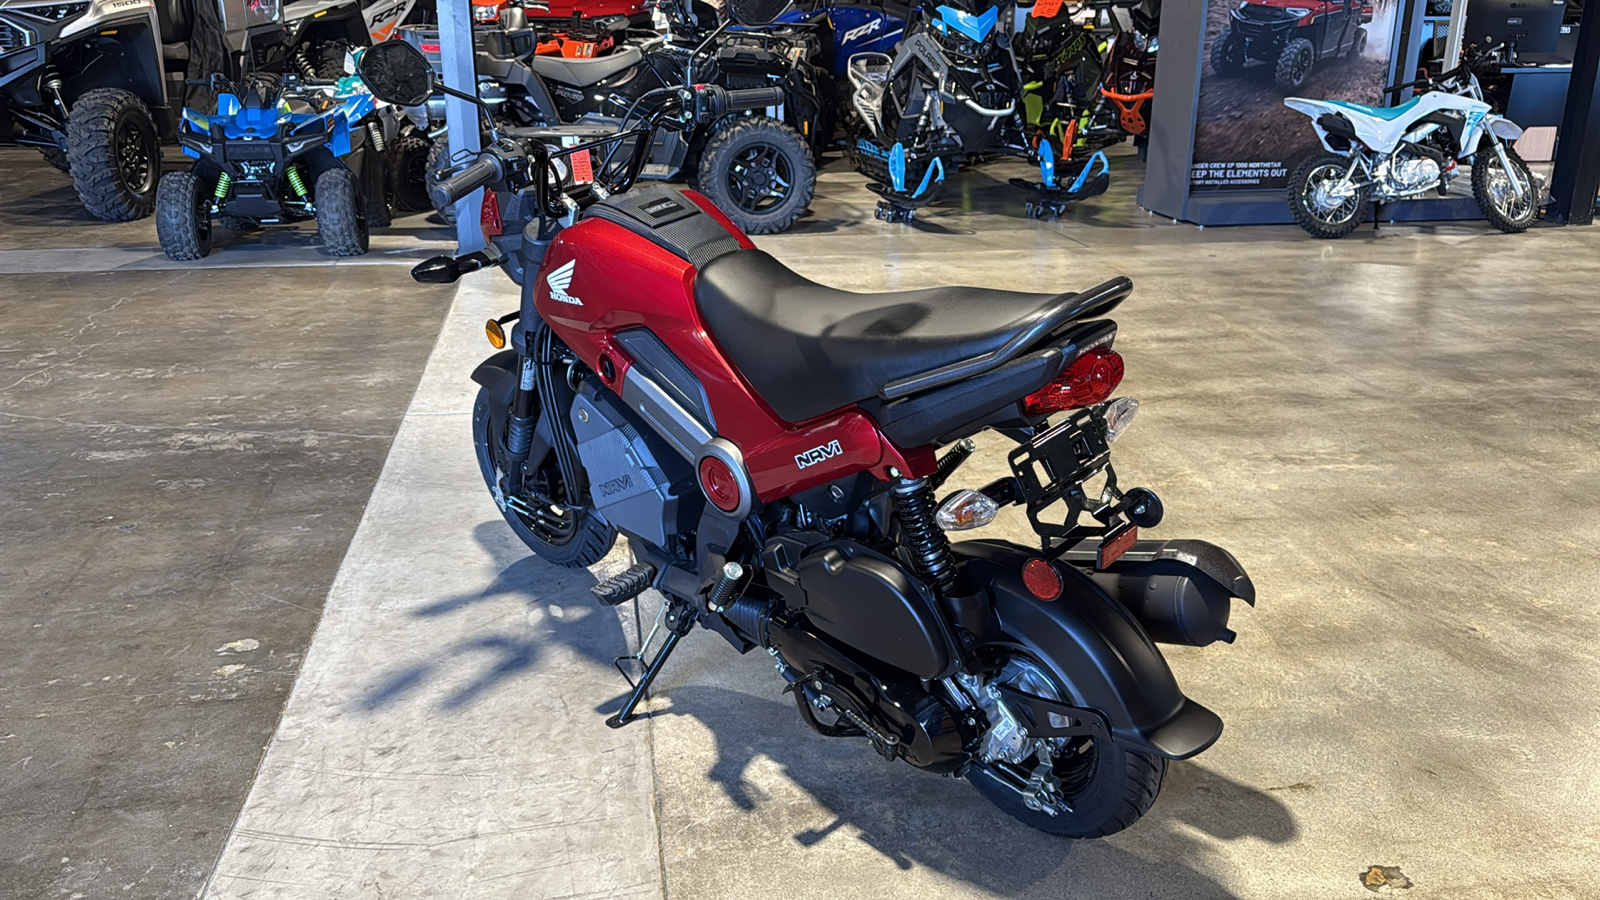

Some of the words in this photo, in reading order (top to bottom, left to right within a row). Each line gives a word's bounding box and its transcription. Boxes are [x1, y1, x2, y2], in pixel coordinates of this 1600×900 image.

[369, 1, 407, 29] RZR
[841, 18, 882, 46] RZR
[914, 39, 941, 72] POLARIS
[1191, 169, 1208, 179] EEP
[1208, 169, 1225, 178] THE
[1226, 169, 1269, 178] ELEMENTS
[1271, 168, 1288, 177] OUT
[549, 291, 584, 306] HONDA
